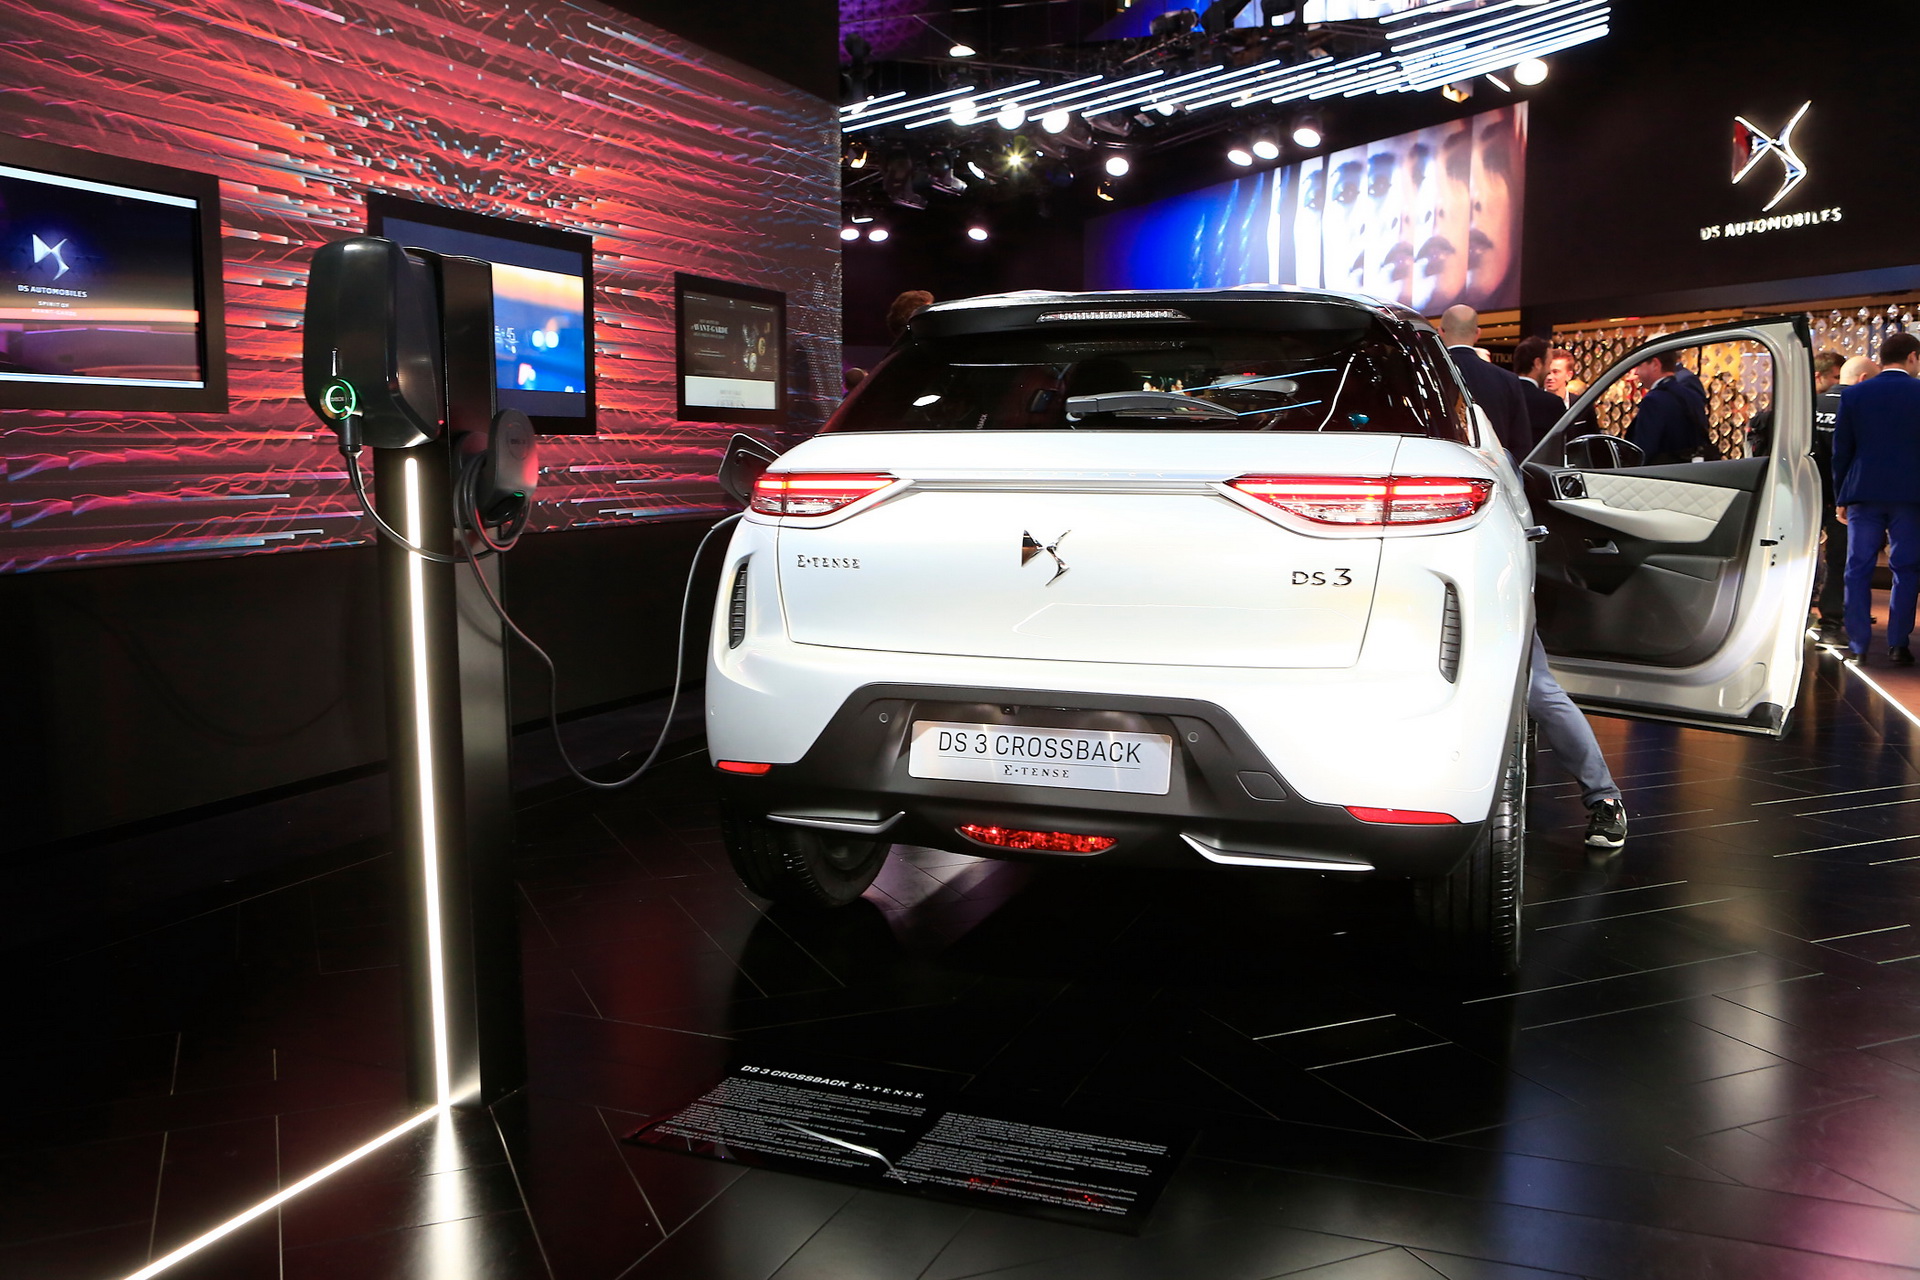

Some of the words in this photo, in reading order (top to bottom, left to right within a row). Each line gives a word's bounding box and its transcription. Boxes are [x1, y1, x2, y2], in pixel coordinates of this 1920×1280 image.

[1700, 225, 1721, 241] DS
[1724, 207, 1843, 237] AUTOMOBILES
[30, 287, 88, 298] AUTOMOBILES
[1291, 570, 1327, 586] DS
[1332, 567, 1353, 587] 3
[938, 731, 968, 753] DS
[974, 733, 988, 754] 3
[995, 735, 1142, 764] CROSSBACK
[740, 1065, 760, 1073] DS
[770, 1070, 850, 1088] CROSSBACK
